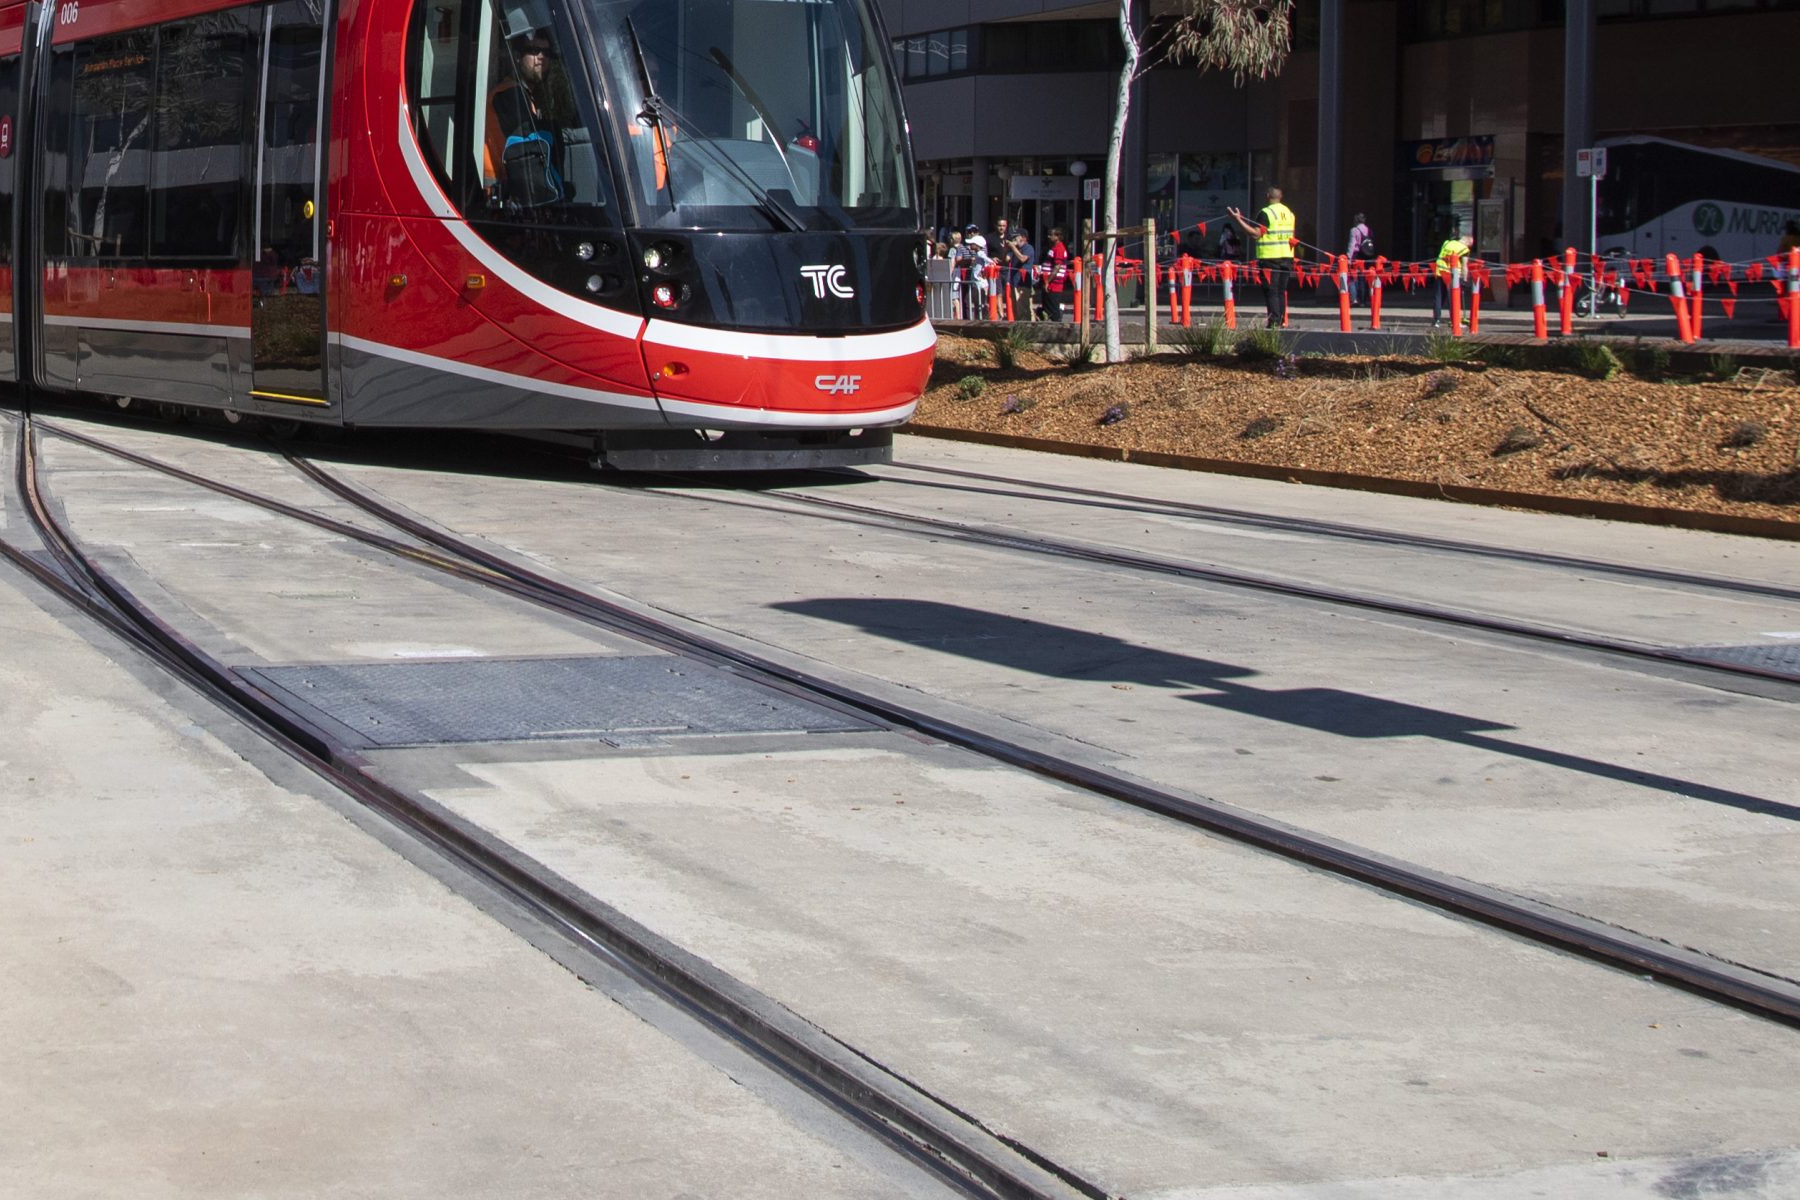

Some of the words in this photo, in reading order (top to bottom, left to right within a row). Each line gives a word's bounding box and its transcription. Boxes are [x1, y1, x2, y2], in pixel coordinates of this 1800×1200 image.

[61, 1, 79, 25] 006
[800, 264, 854, 298] TC
[814, 375, 861, 394] CAF
